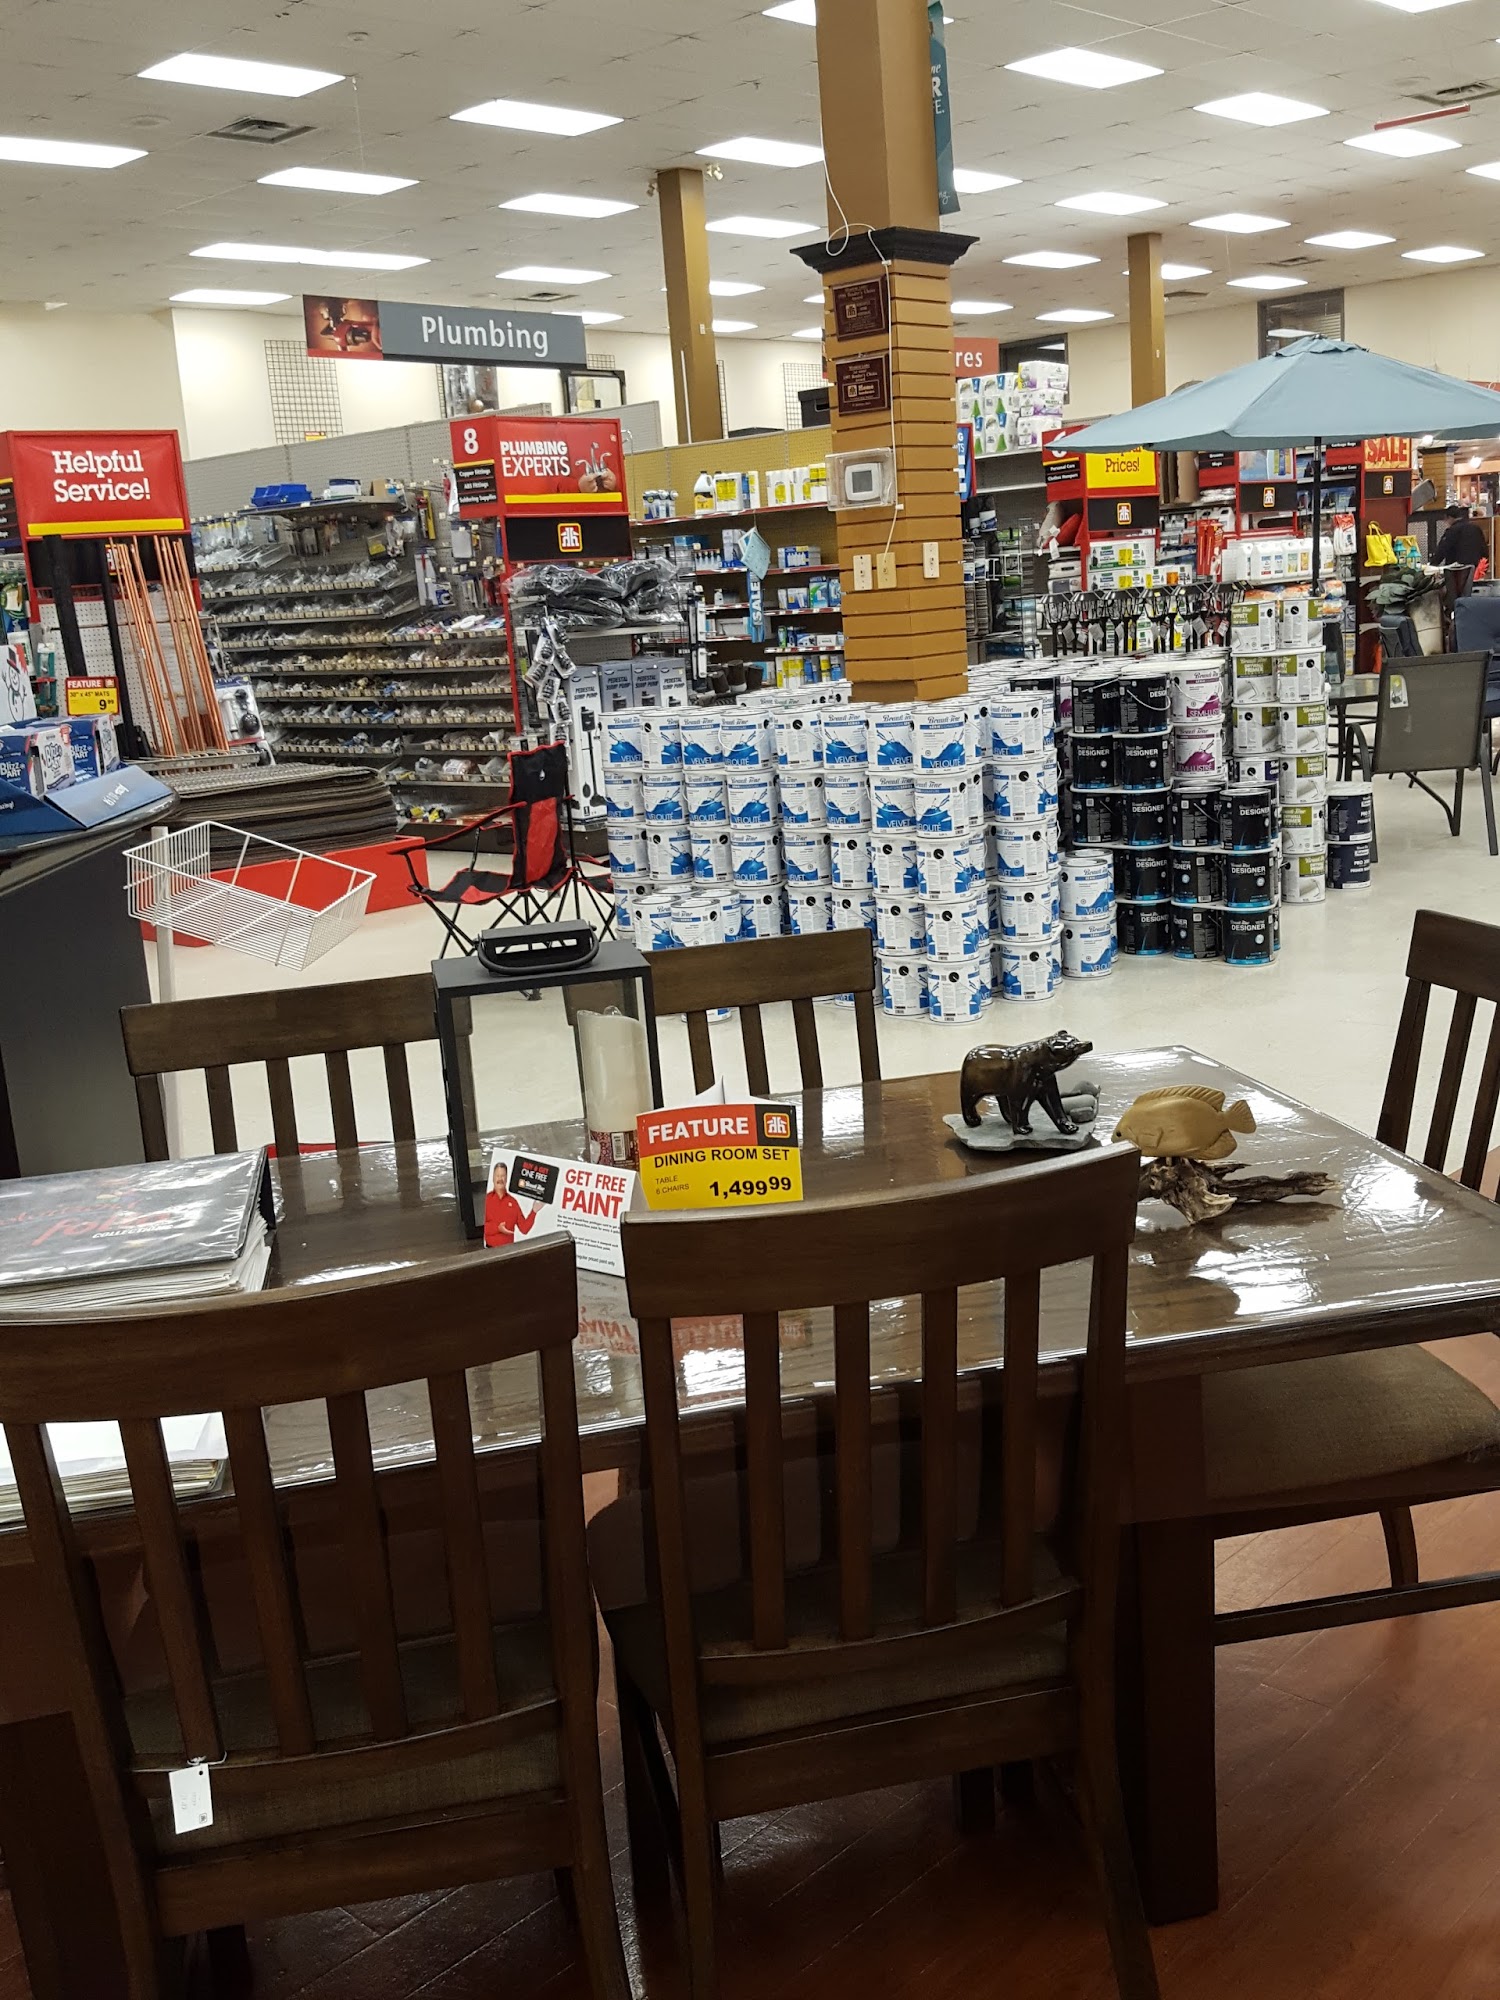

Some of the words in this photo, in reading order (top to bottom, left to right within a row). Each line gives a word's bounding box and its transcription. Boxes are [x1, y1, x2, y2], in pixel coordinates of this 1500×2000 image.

[421, 315, 549, 358] Plumbing
[955, 351, 983, 368] res
[464, 428, 479, 455] 8
[500, 441, 568, 455] PLUMBING
[1366, 436, 1409, 463] SALE
[52, 450, 144, 478] Helpful
[501, 456, 571, 477] EXPERTS
[1105, 457, 1140, 473] Prices!
[53, 478, 151, 503] Service!
[750, 581, 763, 623] SALE
[67, 680, 102, 688] FEATURE
[1132, 804, 1164, 812] DESIGNER
[1231, 865, 1266, 874] DESIGNER
[1231, 923, 1265, 931] DESIGNER
[648, 1117, 749, 1144] FEATURE
[654, 1150, 706, 1169] DINING
[711, 1148, 758, 1161] ROOM
[762, 1148, 790, 1161] SET
[521, 1168, 535, 1179] ONE
[535, 1172, 549, 1183] FREE
[565, 1168, 593, 1187] GET
[595, 1172, 627, 1193] FREE
[655, 1175, 678, 1184] TABLE
[662, 1183, 690, 1194] CHAIRS
[561, 1187, 623, 1220] PAINT
